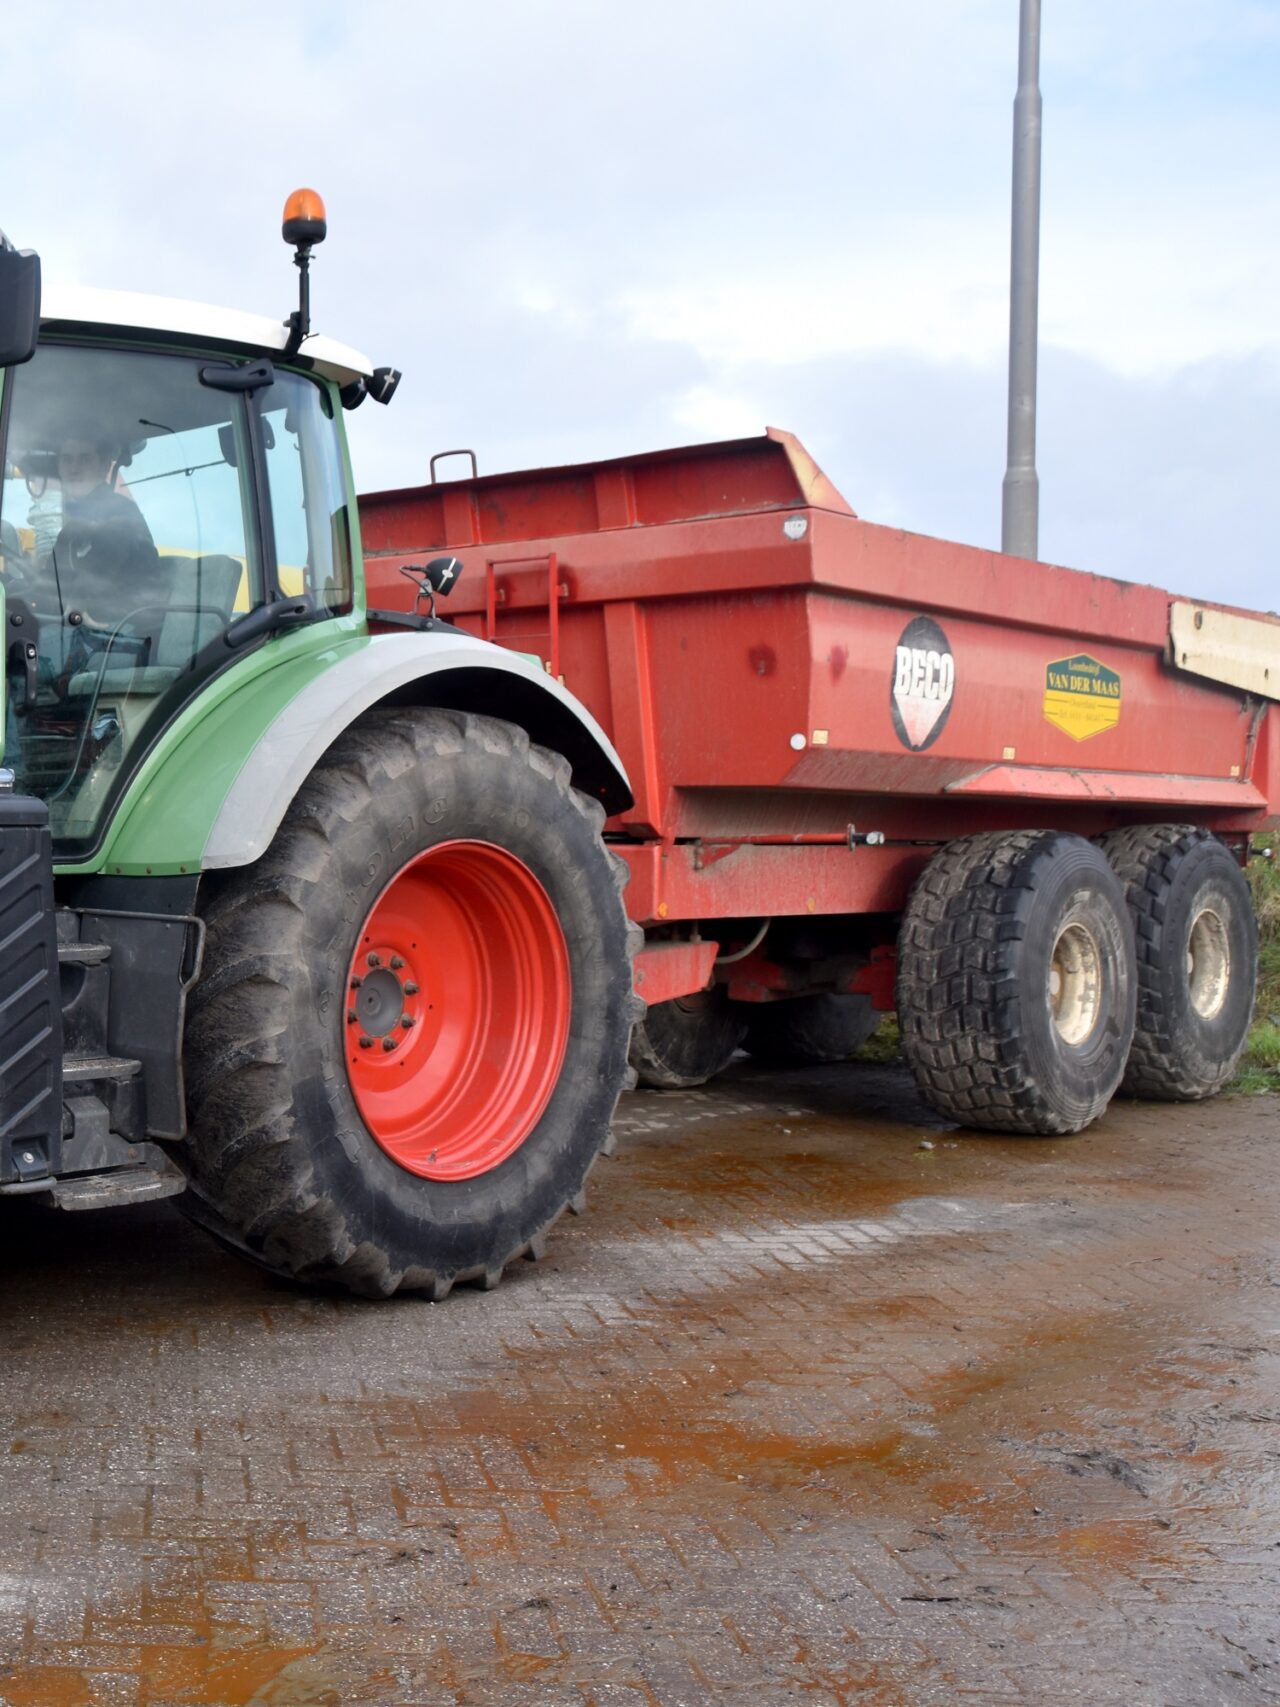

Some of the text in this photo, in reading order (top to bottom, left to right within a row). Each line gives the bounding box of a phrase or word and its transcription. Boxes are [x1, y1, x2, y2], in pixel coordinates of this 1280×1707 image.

[893, 645, 955, 702] BECO
[1048, 672, 1120, 696] VAN DER MAAS
